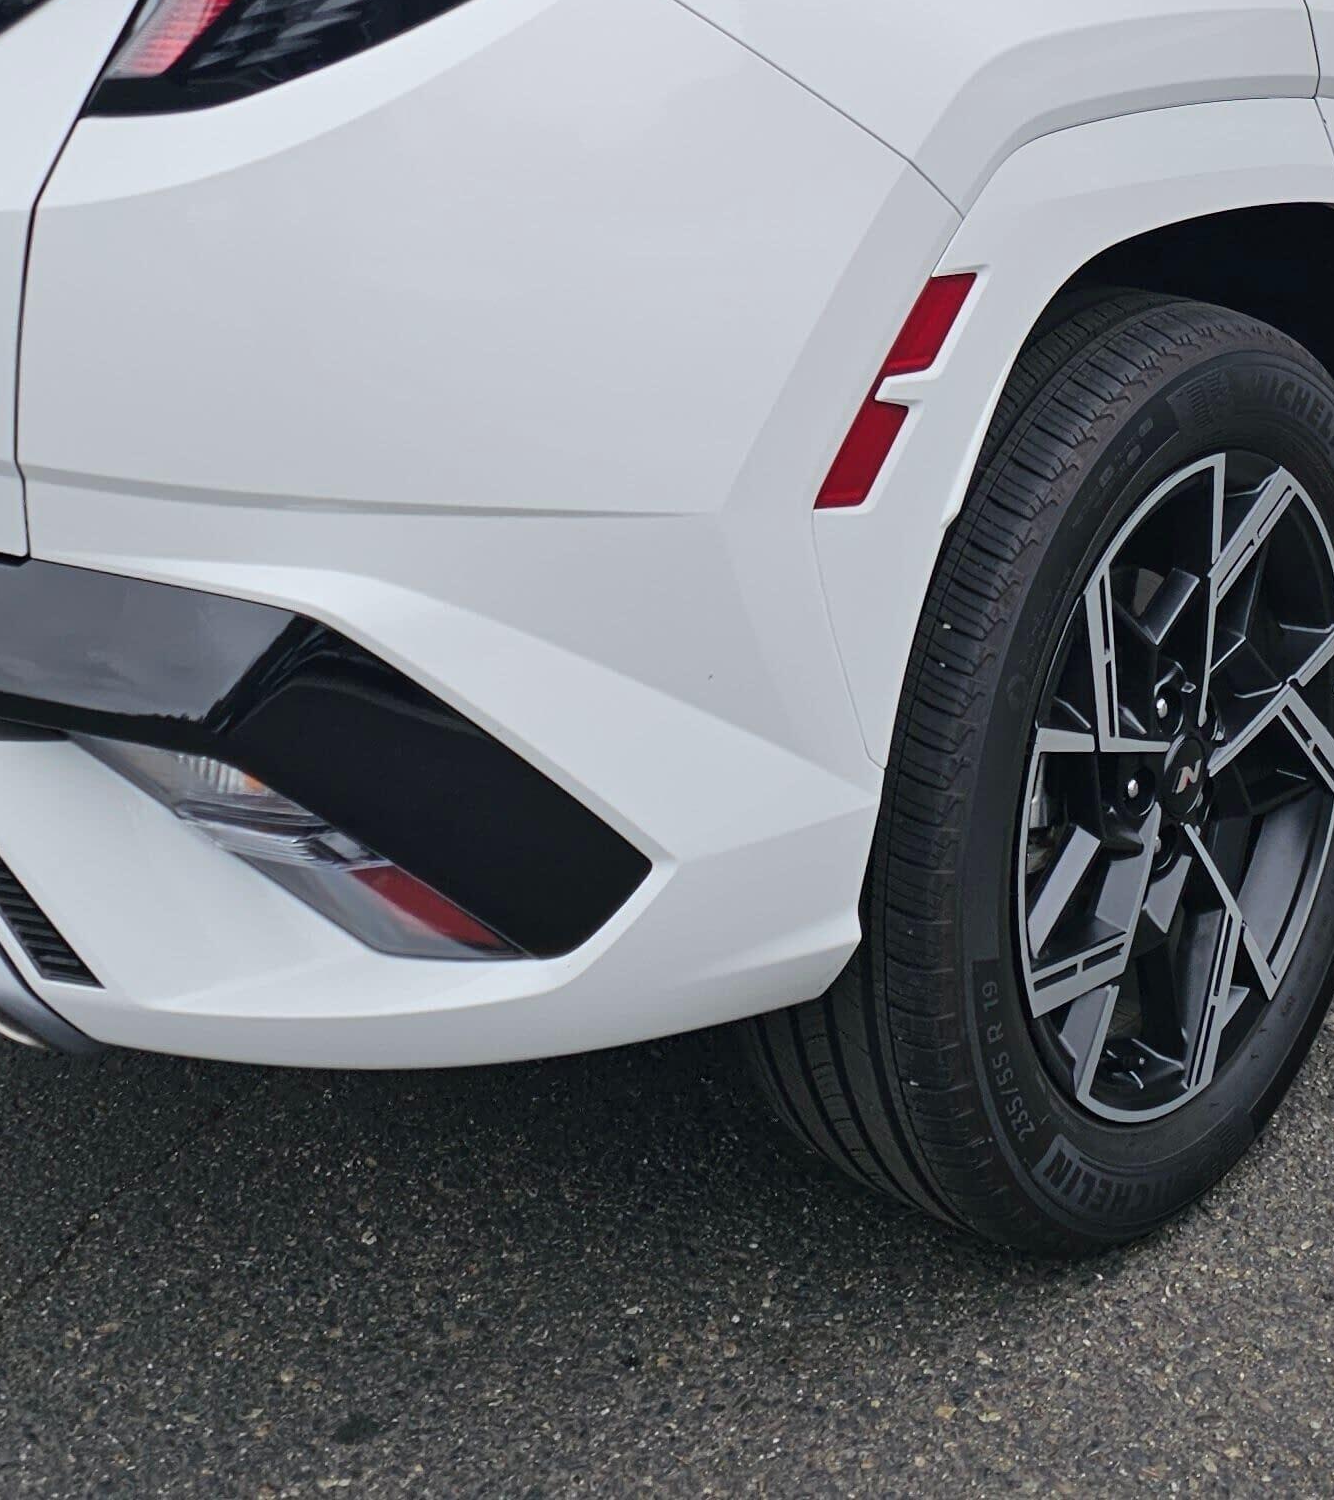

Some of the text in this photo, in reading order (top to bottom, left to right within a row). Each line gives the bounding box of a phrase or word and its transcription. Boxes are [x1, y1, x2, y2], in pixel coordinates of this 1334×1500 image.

[980, 980, 1036, 1142] 235/55 R 19
